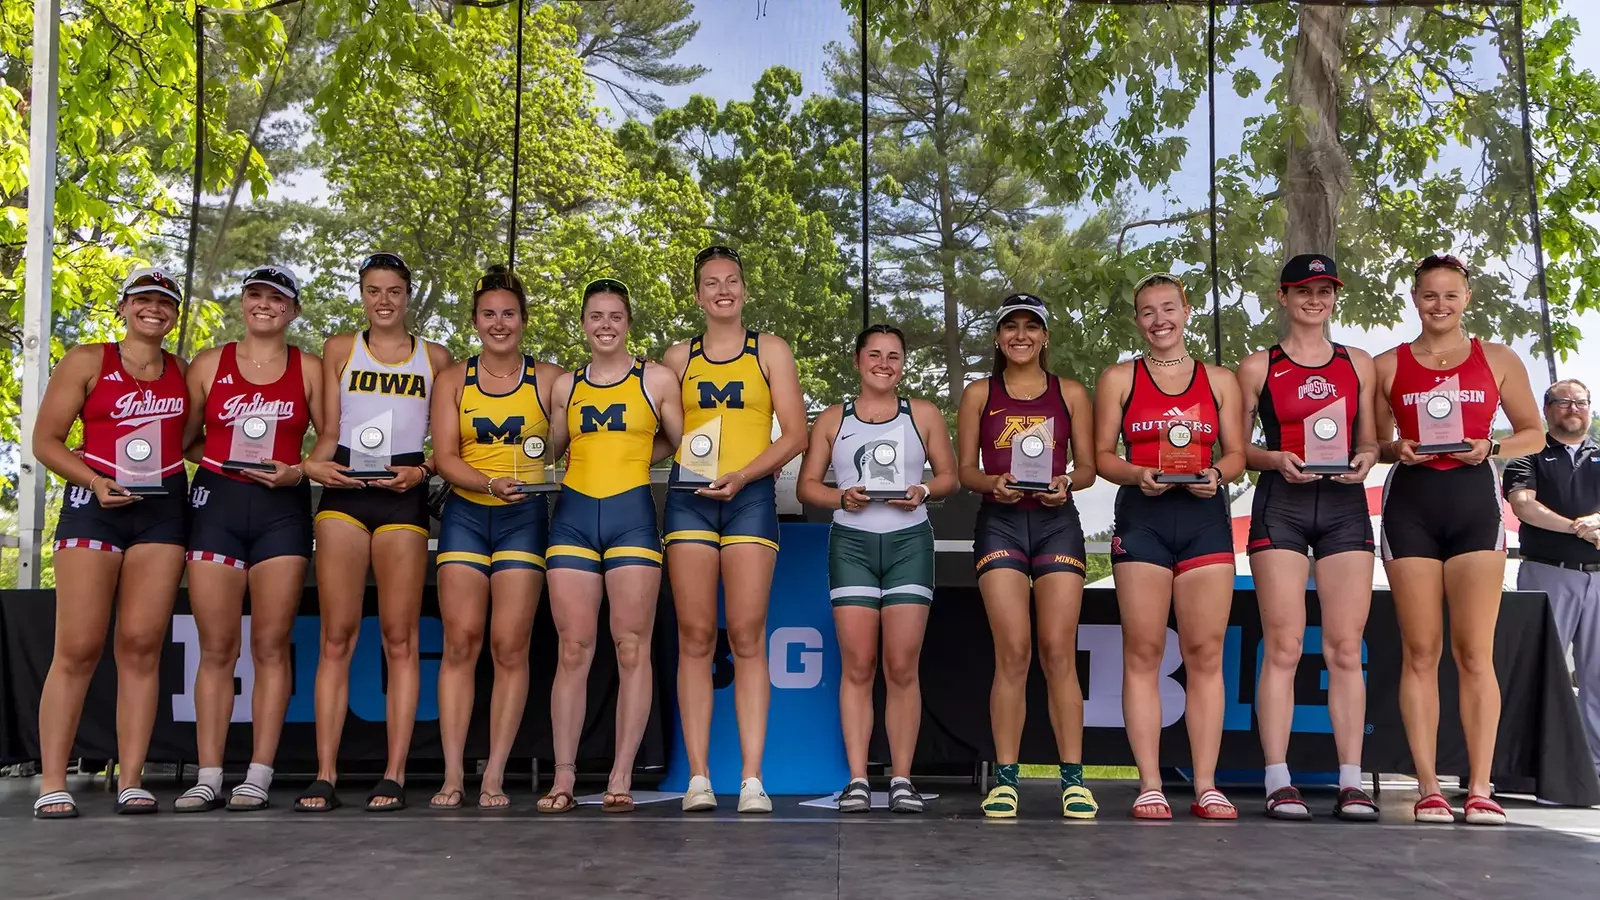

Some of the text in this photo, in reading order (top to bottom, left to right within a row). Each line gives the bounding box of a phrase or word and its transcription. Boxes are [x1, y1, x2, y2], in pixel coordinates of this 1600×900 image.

[348, 370, 426, 399] IOWA
[697, 381, 744, 409] M
[1314, 380, 1338, 398] STATE
[110, 389, 184, 420] Indiana
[218, 392, 294, 421] Indiana
[580, 403, 626, 433] M
[472, 416, 525, 444] M
[994, 416, 1056, 449] M
[1131, 419, 1212, 434] RUTGERS
[976, 549, 1010, 571] MINNESOTA
